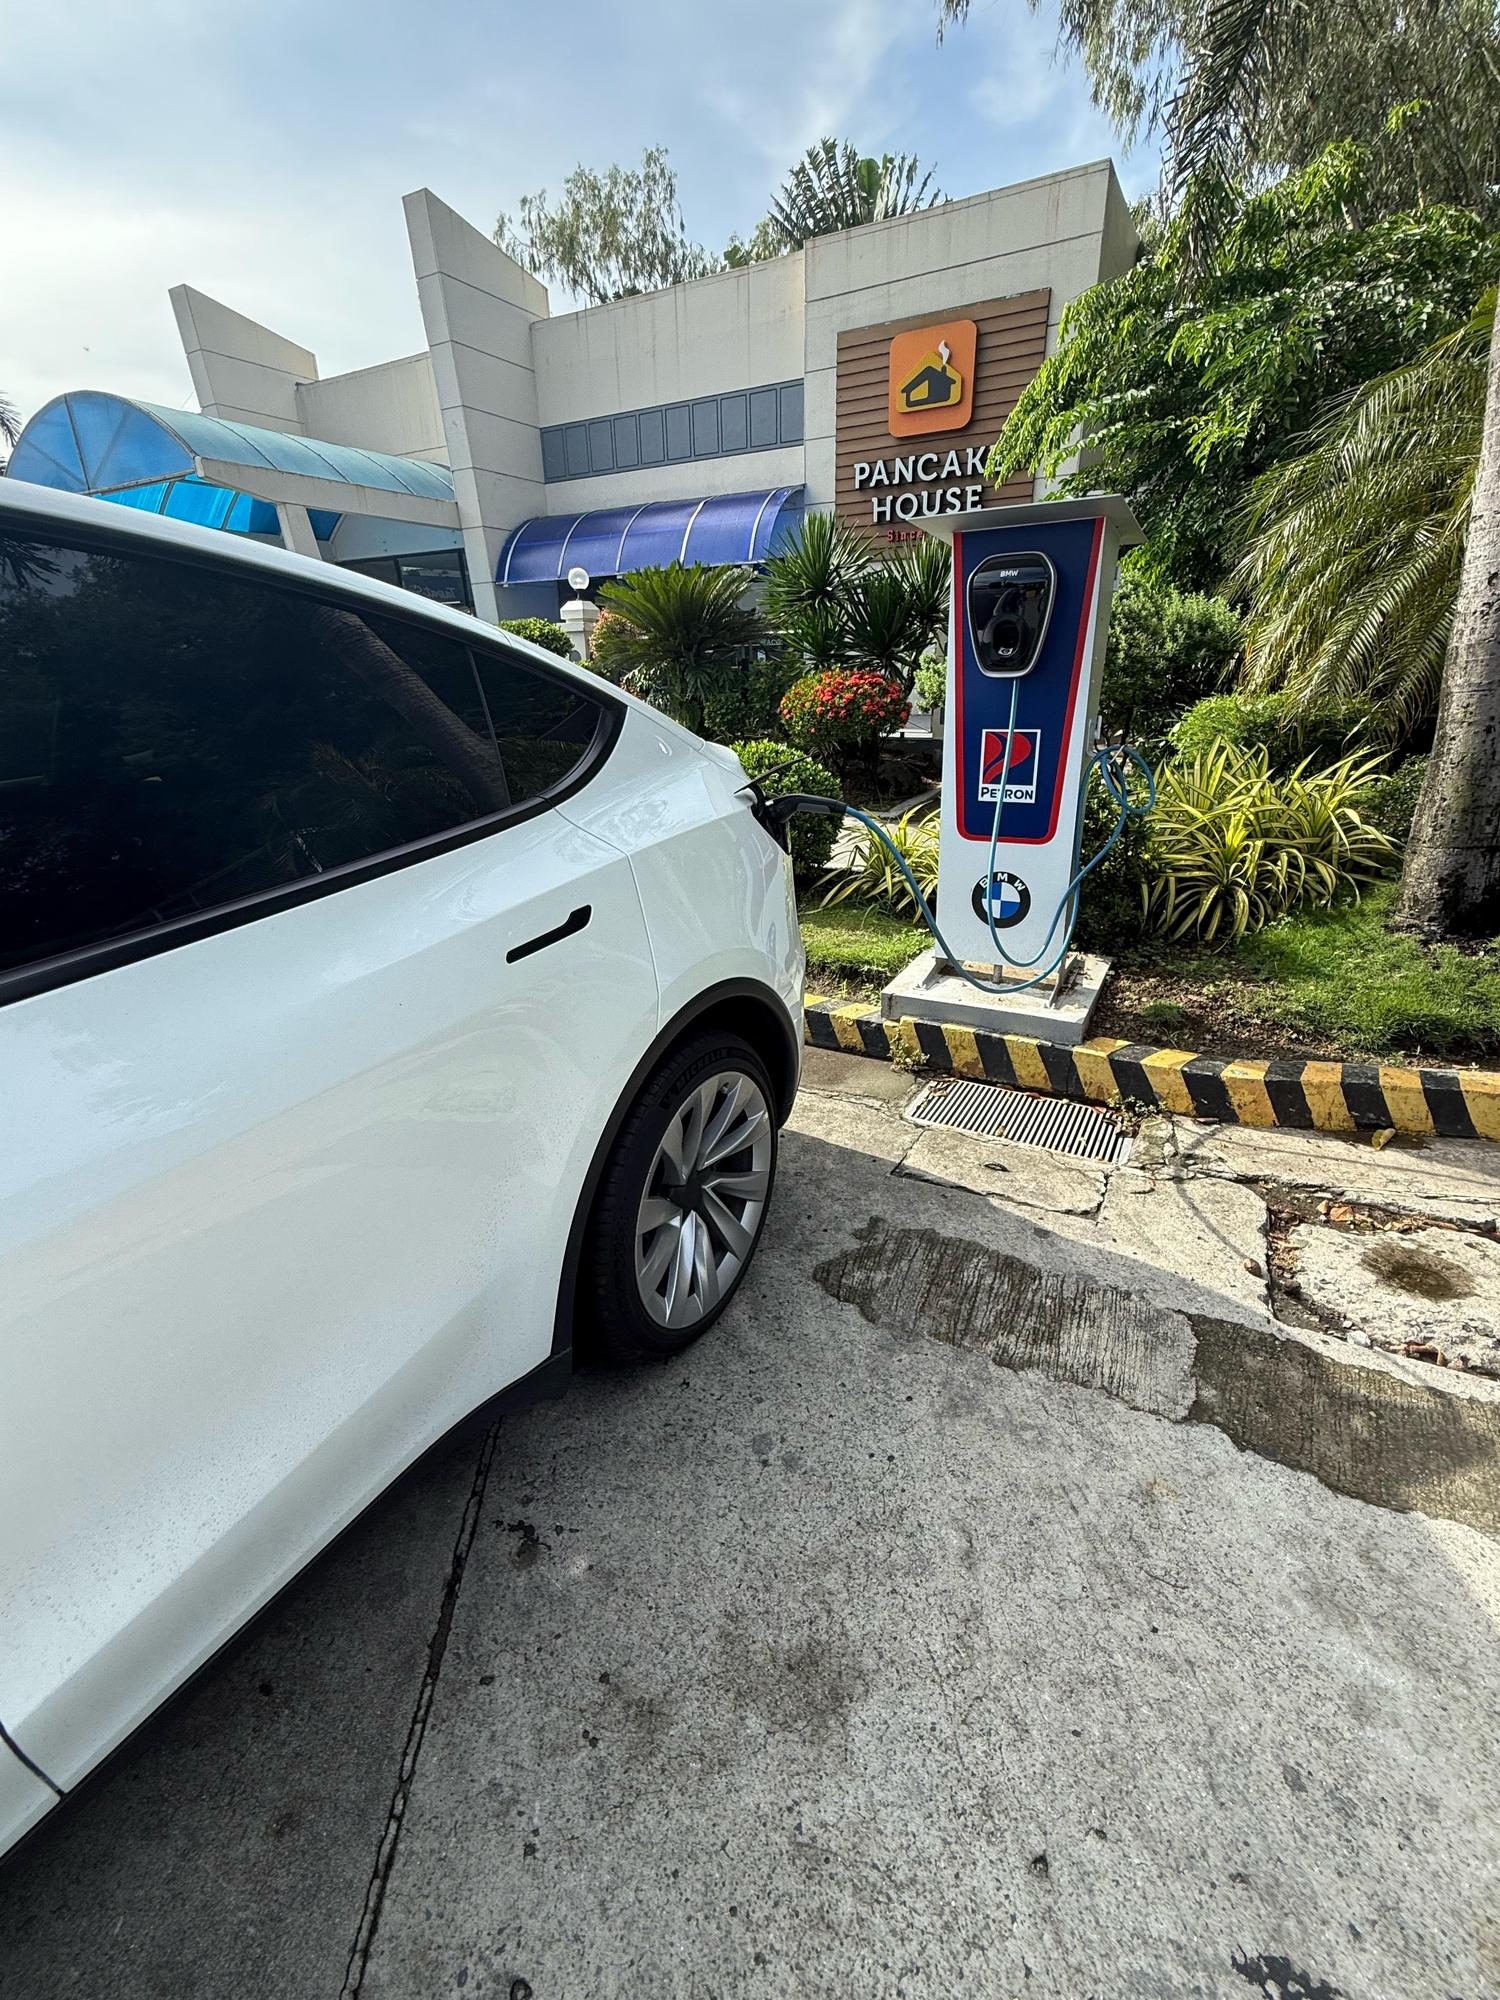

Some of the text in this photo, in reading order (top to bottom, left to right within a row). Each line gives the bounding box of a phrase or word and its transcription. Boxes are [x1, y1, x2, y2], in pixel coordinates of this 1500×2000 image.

[854, 445, 1002, 489] PANCAK
[872, 485, 982, 522] HOUSE
[981, 787, 1033, 800] PERON
